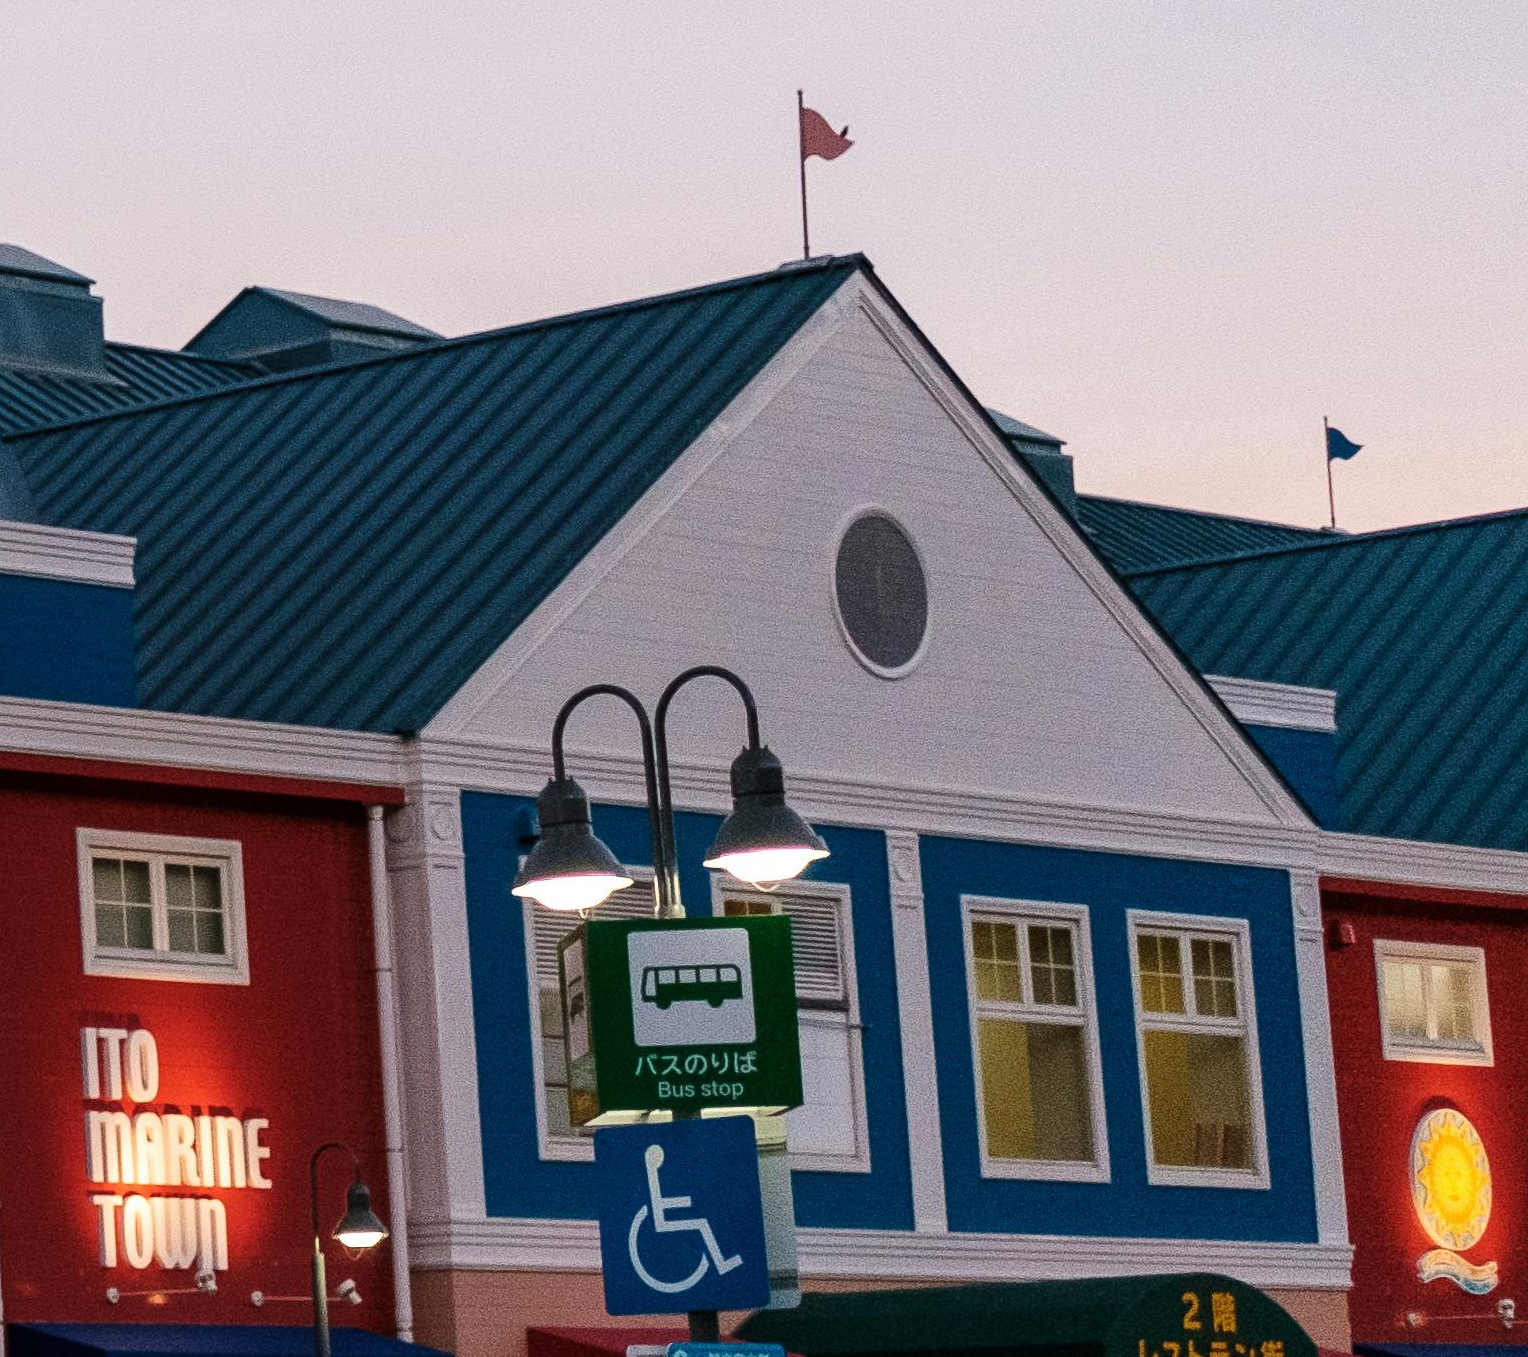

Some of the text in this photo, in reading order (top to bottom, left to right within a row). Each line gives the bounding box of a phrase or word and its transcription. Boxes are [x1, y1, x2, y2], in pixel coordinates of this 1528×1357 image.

[80, 1026, 159, 1103] ITO
[635, 1051, 758, 1076] バスのりば
[659, 1080, 744, 1100] Bus stop
[85, 1110, 272, 1190] MARINE
[90, 1194, 228, 1271] TOWN
